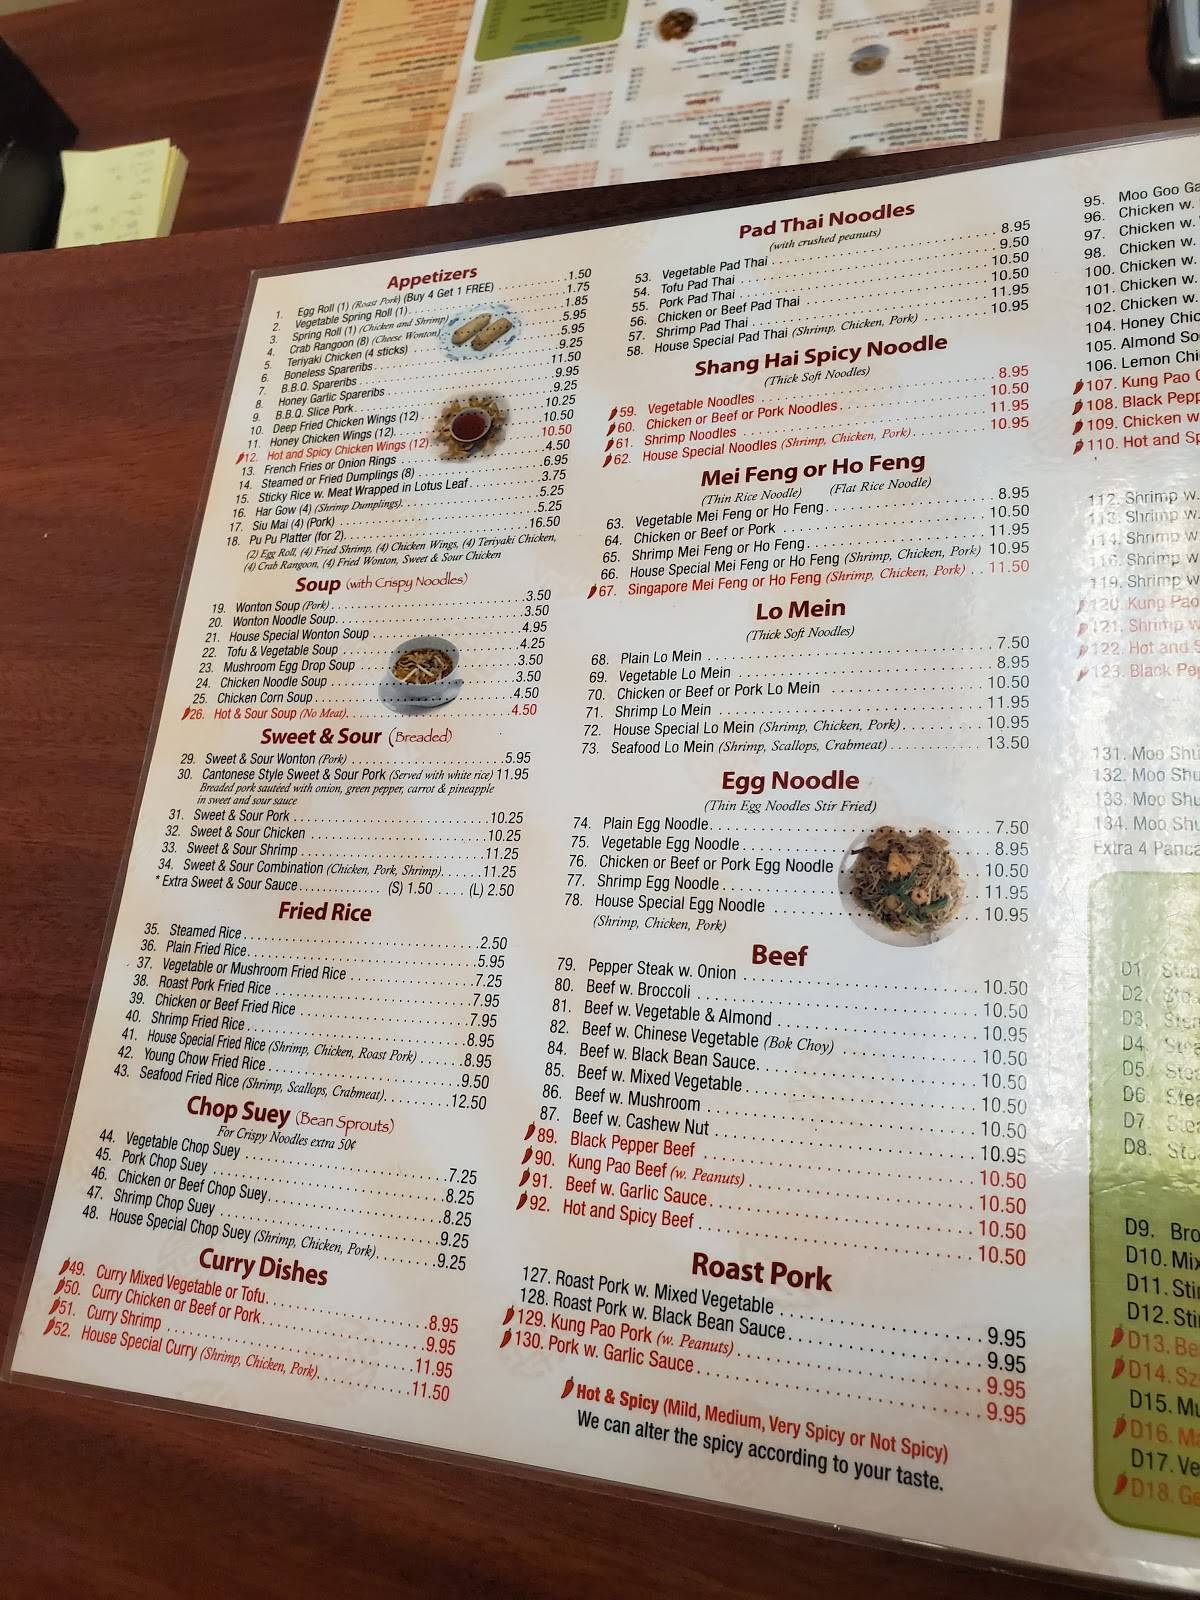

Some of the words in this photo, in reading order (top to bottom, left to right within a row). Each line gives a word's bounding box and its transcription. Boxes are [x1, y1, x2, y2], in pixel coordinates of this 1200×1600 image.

[1083, 194, 1105, 208] 95.
[1118, 190, 1148, 202] Moo
[1152, 185, 1180, 198] Goo
[739, 220, 776, 239] Pad
[780, 213, 824, 233] Thai
[828, 203, 915, 227] Noodles
[769, 239, 795, 253] (with
[797, 233, 837, 247] crushed
[837, 227, 882, 244] peanuts)
[386, 267, 478, 291] Appetizers
[629, 315, 647, 327] 56.
[657, 309, 702, 324] Chicken
[705, 307, 718, 317] or
[721, 301, 747, 316] Beef
[750, 299, 772, 312] Pad
[775, 295, 800, 309] Thai
[991, 267, 1029, 282] 10.50
[694, 358, 759, 377] Shang
[764, 349, 799, 369] Hai
[804, 345, 862, 367] Spicy
[867, 334, 948, 358] Noodle
[764, 373, 799, 388] (Thick
[801, 370, 822, 384] Soft
[824, 365, 871, 380] Noodles)
[1086, 378, 1117, 392] 107.
[1122, 375, 1158, 389] Kung
[1163, 372, 1191, 385] Pao
[245, 452, 257, 463] 12.
[267, 450, 284, 461] Hot
[285, 448, 305, 460] and
[305, 446, 333, 460] Spicy
[334, 443, 374, 456] Chicken
[376, 440, 406, 453] Wings
[408, 437, 429, 451] (12)
[542, 423, 572, 437] 10.50
[1087, 437, 1119, 451] 110.
[1123, 434, 1149, 448] Hot
[1152, 431, 1180, 446] and
[236, 493, 249, 504] 15.
[258, 491, 288, 504] Sticky
[289, 489, 311, 500] Rice
[313, 490, 324, 499] w.
[327, 486, 353, 498] Meat
[355, 482, 400, 497] Wrapped
[401, 482, 412, 493] in
[414, 480, 443, 492] Lotus
[445, 477, 469, 490] Leaf
[541, 468, 566, 482] 3.75
[700, 467, 740, 487] Mei
[745, 466, 798, 484] Feng
[803, 463, 827, 478] or
[832, 457, 864, 475] Ho
[869, 454, 925, 473] Feng
[604, 534, 622, 547] 64.
[633, 530, 681, 545] Chicken
[684, 530, 697, 541] or
[700, 525, 729, 539] Beef
[731, 526, 745, 537] or
[748, 522, 776, 536] Pork
[990, 504, 1030, 518] 10.50
[295, 576, 341, 595] Soup
[345, 575, 373, 591] (with
[374, 576, 413, 594] Crispy
[415, 571, 468, 587] Noodles)
[756, 603, 783, 620] Lo
[788, 598, 846, 619] Mein
[204, 632, 220, 643] 21.
[228, 631, 260, 642] House
[262, 628, 300, 643] Special
[302, 628, 340, 640] Wonton
[342, 627, 370, 641] Soup
[521, 620, 547, 633] 4.95
[260, 728, 317, 745] Sweet
[319, 727, 335, 745] &
[337, 727, 383, 745] Sour
[388, 726, 453, 748] (Breaded)
[721, 771, 765, 795] Egg
[771, 769, 860, 790] Noodle
[569, 854, 587, 868] 76.
[599, 854, 649, 869] Chicken
[653, 858, 667, 869] or
[670, 855, 700, 870] Beef
[703, 859, 717, 870] or
[721, 856, 751, 871] Pork
[755, 857, 781, 875] Egg
[785, 858, 834, 873] Noodle
[985, 862, 1029, 878] 10.50
[278, 901, 329, 921] Fried
[331, 902, 372, 922] Rice
[751, 943, 809, 967] Beef
[136, 956, 153, 969] 37.
[163, 956, 214, 974] Vegetable
[215, 963, 228, 974] or
[230, 961, 288, 977] Mushroom
[290, 964, 320, 979] Fried
[321, 966, 347, 981] Rice
[475, 973, 503, 988] 7.25
[544, 1061, 564, 1078] 85.
[577, 1063, 608, 1081] Beef
[611, 1069, 625, 1083] w.
[629, 1067, 671, 1086] Mixed
[674, 1071, 742, 1093] Vegetable
[981, 1096, 1027, 1115] 10.50
[187, 1095, 238, 1124] Chop
[241, 1100, 291, 1130] Suey
[295, 1110, 334, 1127] (Bean
[335, 1115, 395, 1137] Sprouts)
[95, 1146, 111, 1161] 45.
[121, 1149, 146, 1166] Pork
[149, 1152, 177, 1172] Chop
[179, 1156, 208, 1176] Suey
[445, 1188, 475, 1206] 8.25
[529, 1194, 550, 1212] 92.
[563, 1198, 587, 1217] Hot
[589, 1203, 616, 1220] and
[619, 1204, 657, 1228] Spicy
[661, 1209, 695, 1229] Beef
[978, 1244, 1026, 1267] 10.50
[1125, 1217, 1155, 1239] D9.
[199, 1247, 256, 1280] Curry
[258, 1255, 328, 1286] Dishes
[691, 1251, 765, 1284] Roast
[770, 1261, 833, 1292] Pork
[1125, 1244, 1168, 1267] D10.
[522, 1265, 551, 1285] 127.
[555, 1269, 595, 1291] Roast
[598, 1275, 630, 1295] Pork
[634, 1283, 649, 1298] w.
[654, 1282, 698, 1305] Mixed
[701, 1288, 774, 1315] Vegetable
[987, 1326, 1026, 1349] 9.95
[1127, 1301, 1170, 1325] D12.
[58, 1300, 75, 1317] 51.
[86, 1304, 119, 1326] Curry
[120, 1309, 162, 1333] Shrimp
[416, 1357, 453, 1379] 11.95
[576, 1383, 601, 1402] Hot
[603, 1388, 616, 1405] &
[619, 1390, 660, 1415] Spicy
[663, 1397, 701, 1422] (Mild,
[704, 1404, 766, 1433] Medium,
[768, 1415, 801, 1440] Very
[805, 1421, 846, 1447] Spicy
[849, 1432, 866, 1447] or
[870, 1431, 897, 1453] Not
[900, 1437, 949, 1465] Spicy)
[577, 1409, 600, 1429] We
[603, 1418, 630, 1435] can
[634, 1421, 670, 1442] alter
[673, 1426, 698, 1447] the
[702, 1434, 744, 1459] spicy
[747, 1443, 828, 1475] according
[832, 1454, 849, 1474] to
[853, 1461, 892, 1482] your
[895, 1465, 944, 1492] taste.
